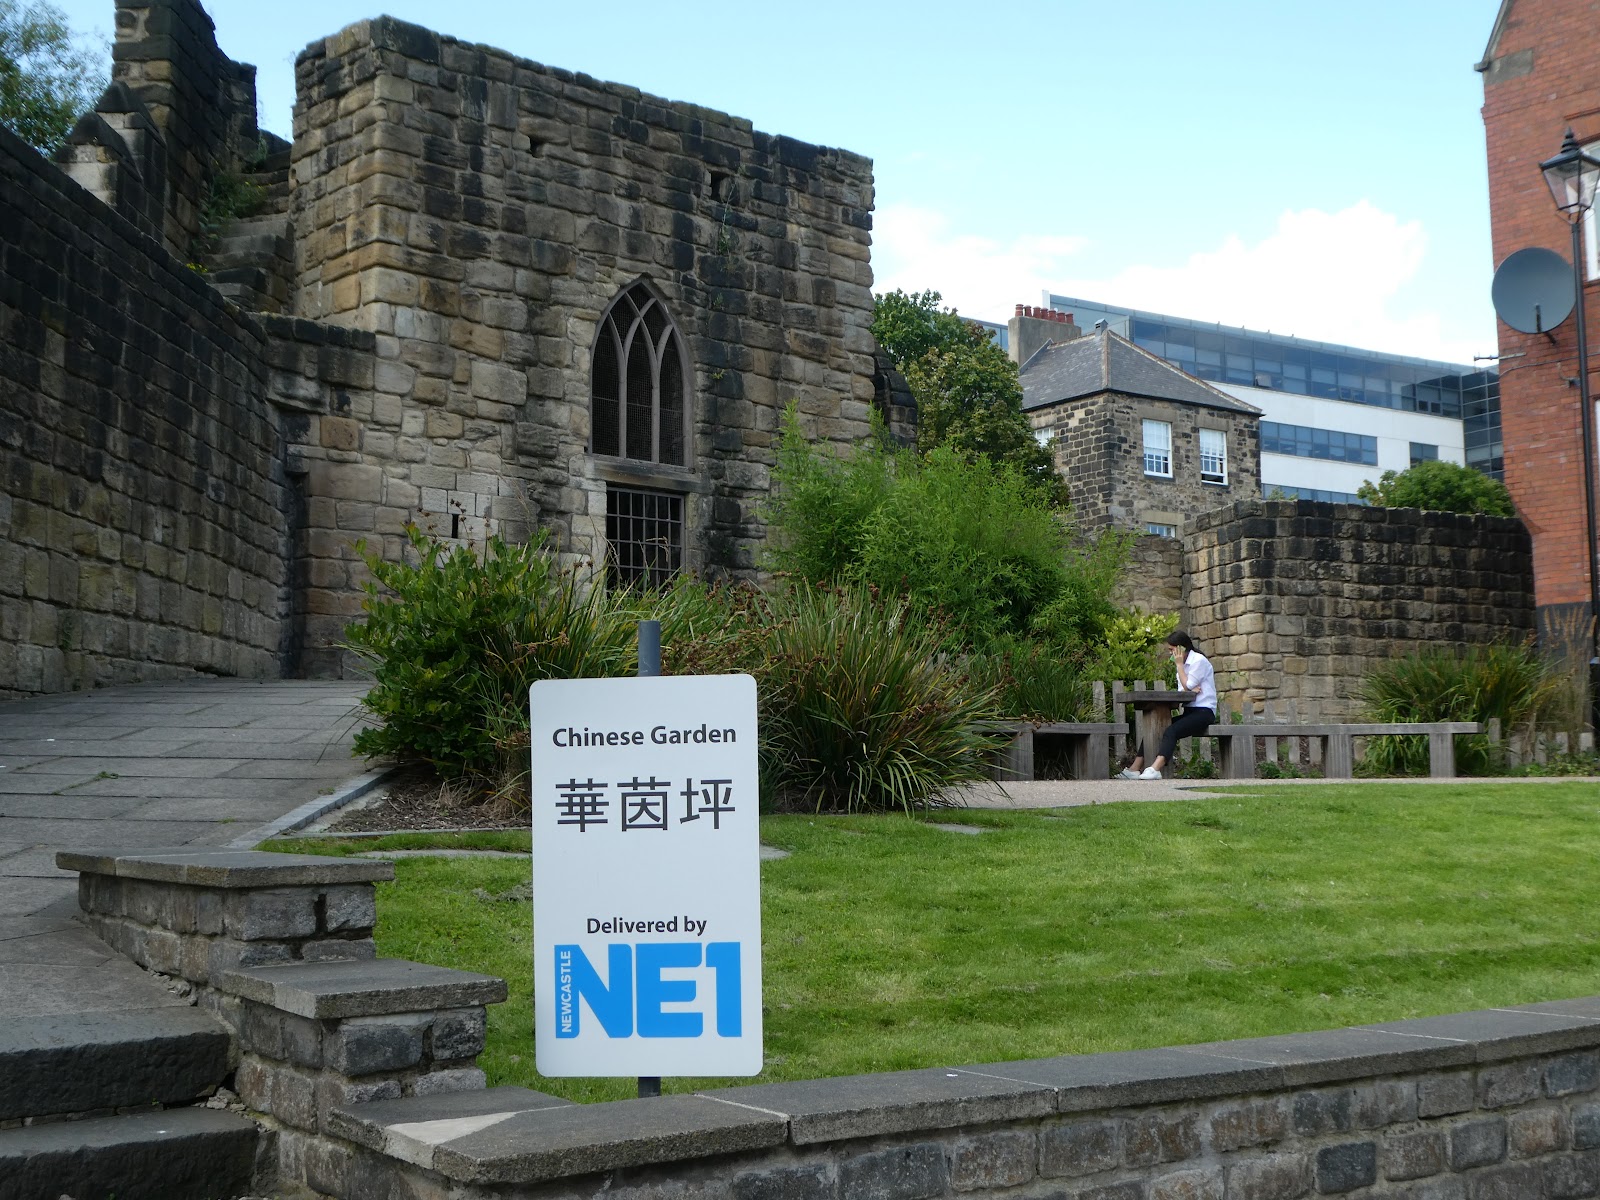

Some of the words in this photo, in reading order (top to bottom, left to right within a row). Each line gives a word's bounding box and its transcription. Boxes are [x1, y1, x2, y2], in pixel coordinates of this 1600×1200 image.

[552, 727, 644, 748] Chinese
[650, 723, 737, 745] Garden
[555, 776, 736, 832] 華茵坪
[586, 915, 678, 934] Delivered
[683, 915, 707, 937] by
[554, 941, 742, 1039] NE1
[560, 950, 572, 1033] NEWCASTLE
